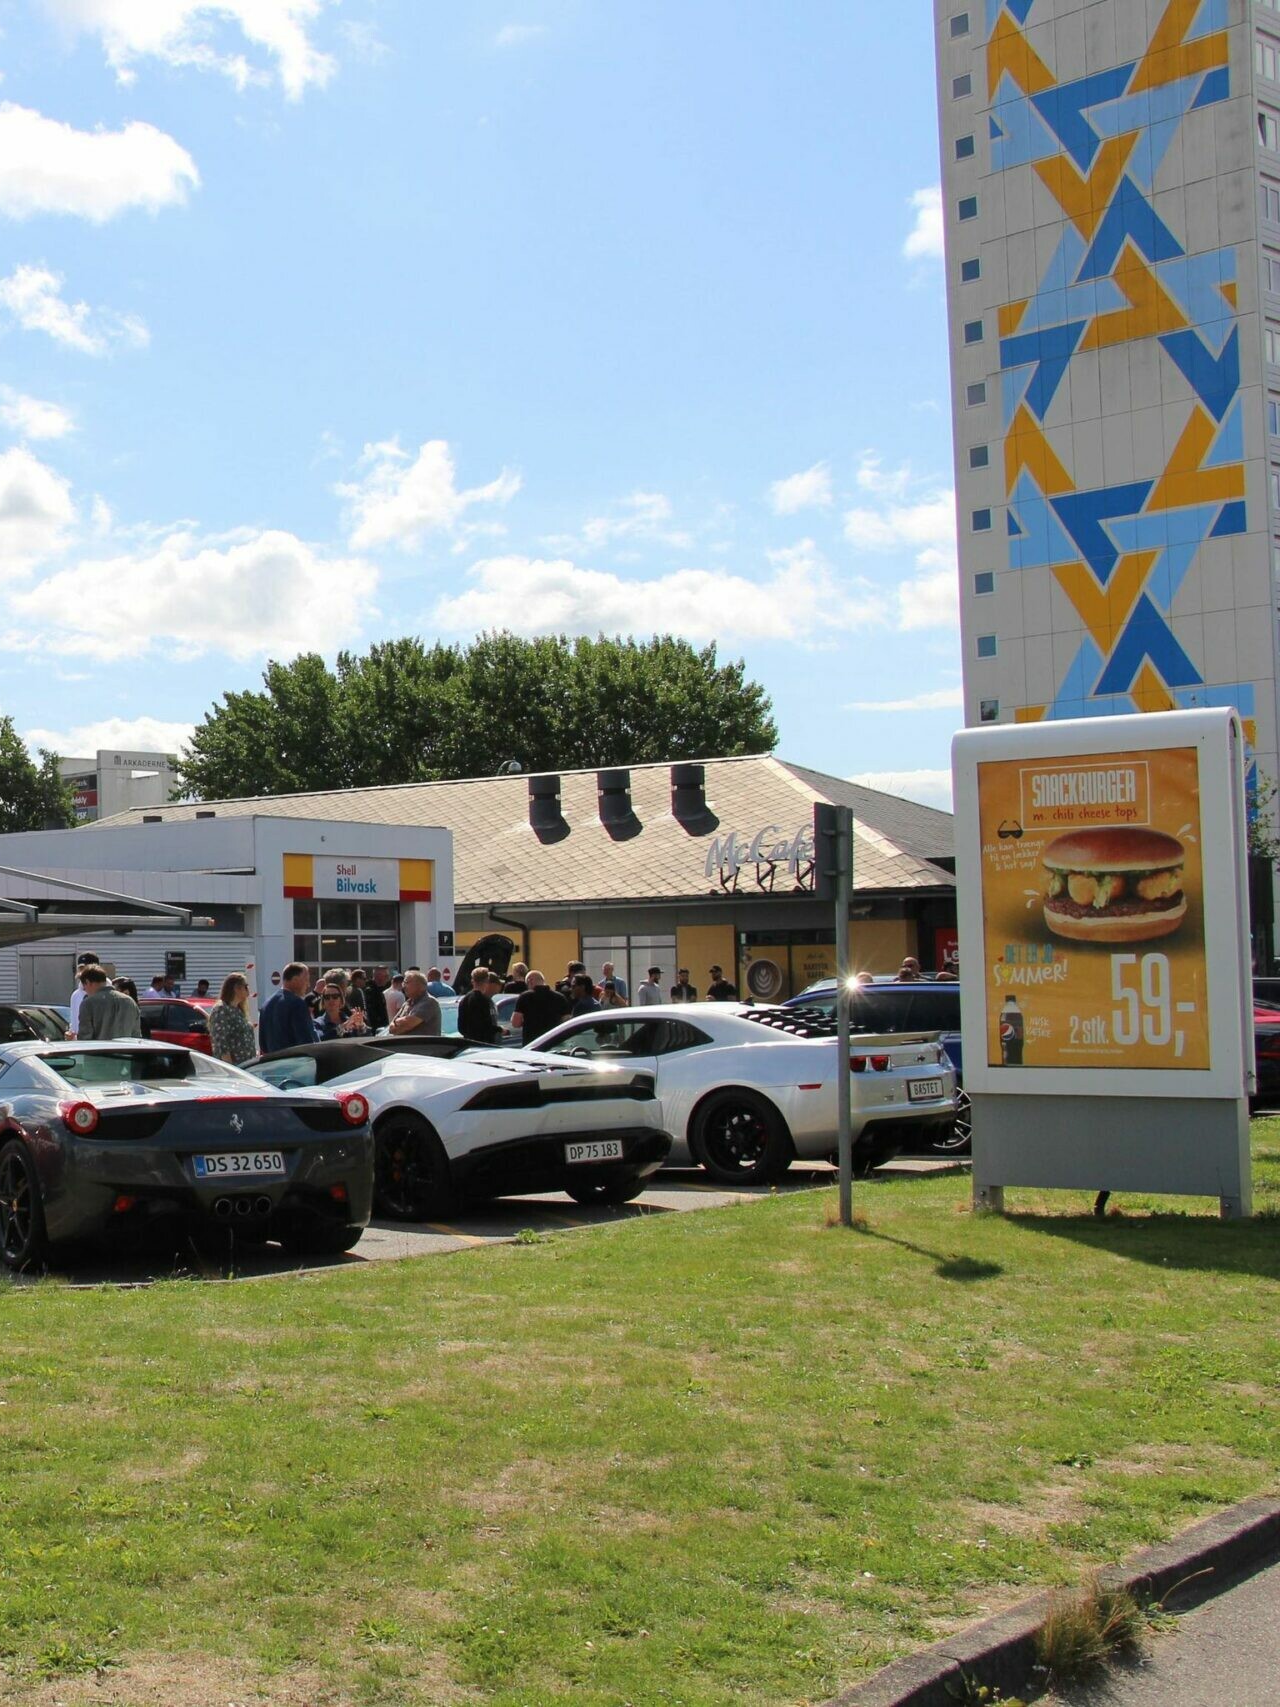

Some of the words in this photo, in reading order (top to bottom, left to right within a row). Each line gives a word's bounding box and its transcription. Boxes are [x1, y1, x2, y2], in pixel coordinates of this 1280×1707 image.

[123, 759, 166, 768] ARKADERNE
[1032, 769, 1136, 807] SNACKBURGER
[1033, 812, 1048, 821] m.
[1053, 807, 1074, 820] chili
[1079, 806, 1111, 819] cheese
[1115, 805, 1138, 821] tops
[336, 864, 356, 875] Shell
[336, 877, 377, 893] Bilvask
[1070, 1015, 1079, 1044] 2
[1082, 1015, 1109, 1044] stk.
[570, 1146, 584, 1159] DP
[586, 1145, 599, 1158] 75
[601, 1143, 619, 1157] 183
[206, 1157, 228, 1172] DS
[231, 1156, 251, 1171] 32
[254, 1154, 282, 1170] 650
